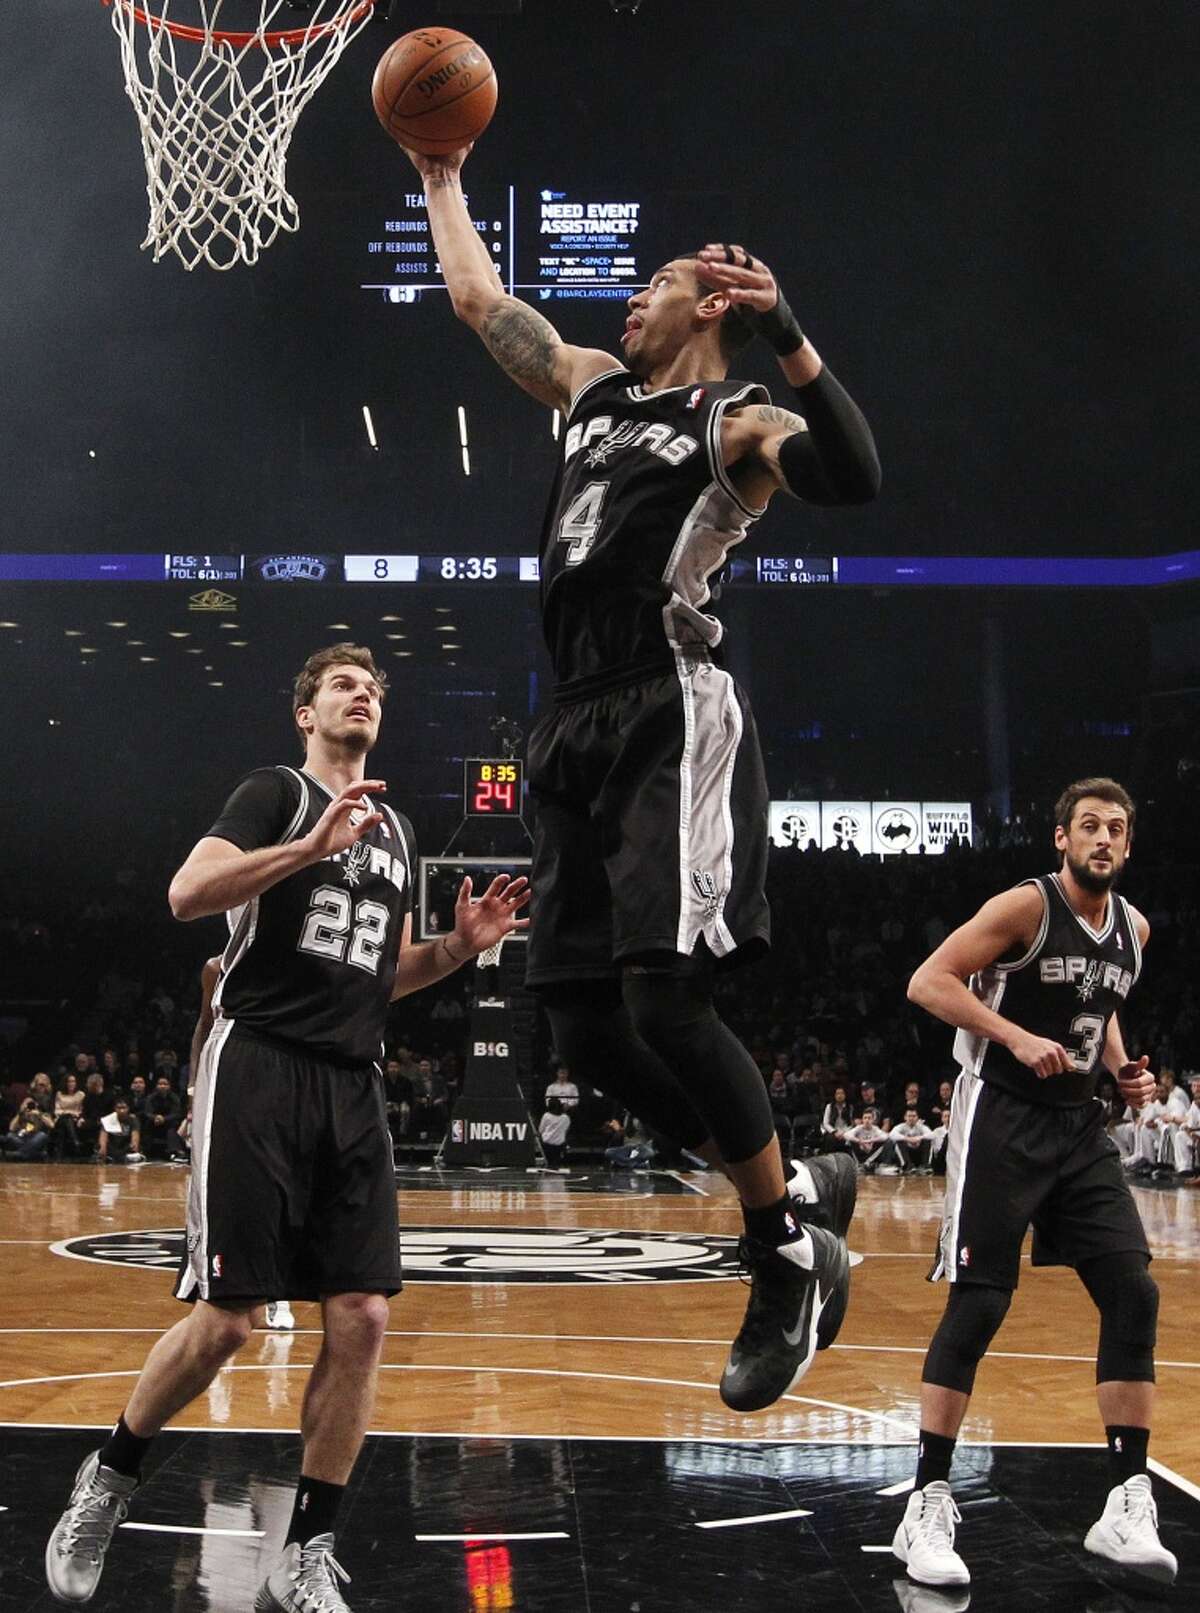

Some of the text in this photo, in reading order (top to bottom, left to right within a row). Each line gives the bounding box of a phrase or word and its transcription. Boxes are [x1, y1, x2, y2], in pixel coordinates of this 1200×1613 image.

[541, 203, 640, 219] NEED EVENT
[385, 221, 428, 232] REBOUNDS
[493, 221, 502, 232] 0
[540, 219, 639, 234] ASSISTANCE?
[368, 242, 383, 253] OFF
[385, 242, 428, 253] REBOUNDS
[492, 242, 502, 253] 0
[395, 263, 428, 273] ASSISTS
[540, 267, 559, 276] AND
[597, 267, 609, 276] TO
[557, 481, 611, 567] 4
[172, 555, 212, 567] FLS: 1
[374, 558, 389, 579] 8
[440, 557, 498, 580] 8:35
[763, 558, 804, 569] FLS: 0
[170, 569, 196, 580] TOL:
[762, 571, 788, 582] TOL:
[481, 765, 516, 781] 8:35
[475, 782, 512, 810] 24
[928, 822, 969, 834] WILD
[297, 884, 391, 976] 22
[1039, 955, 1133, 1002] SPURS
[473, 1042, 509, 1057] BIG
[1064, 1012, 1105, 1074] 3
[470, 1122, 528, 1142] NBA TV
